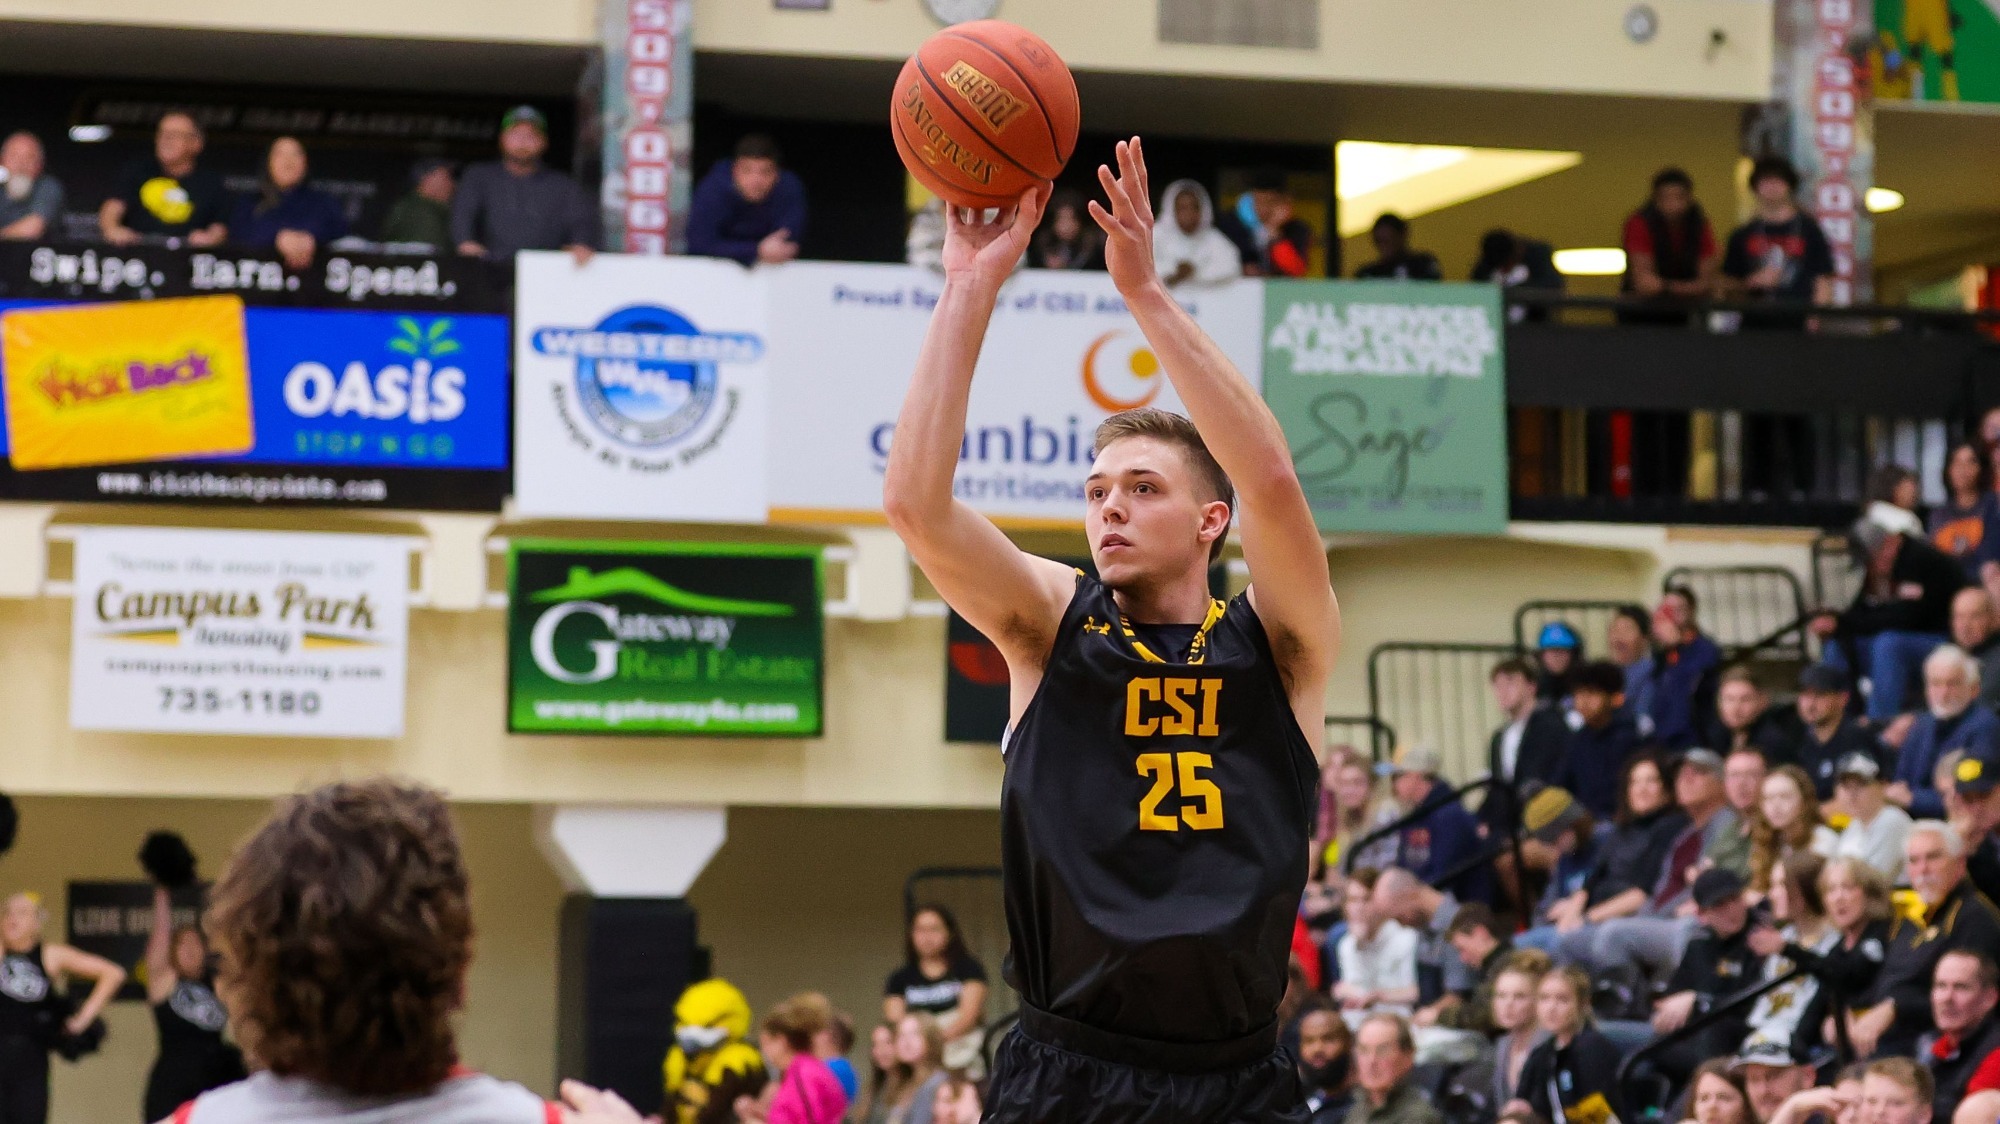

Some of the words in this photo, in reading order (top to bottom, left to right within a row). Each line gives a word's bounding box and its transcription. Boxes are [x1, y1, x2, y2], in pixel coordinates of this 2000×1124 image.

[948, 64, 1024, 130] NJCAA
[902, 80, 999, 185] SPALDING
[30, 247, 165, 295] Swipe.
[191, 254, 300, 291] Earn.
[326, 257, 457, 299] Spend.
[833, 283, 903, 308] Proud
[1286, 303, 1338, 327] ALL
[1346, 304, 1488, 329] SERVICES
[541, 331, 758, 361] WESTERN
[1269, 322, 1315, 349] AT
[1317, 324, 1365, 350] NO
[1369, 325, 1497, 354] CHARGE
[283, 357, 467, 424] OASIS
[97, 471, 387, 501] www.kickbackpoints.com
[96, 583, 262, 630] Campus
[275, 583, 377, 631] Park
[194, 625, 293, 654] housing
[529, 599, 736, 684] Gateway
[104, 658, 383, 683] campusparkhousing.com
[620, 647, 699, 682] Real
[706, 648, 815, 683] Estate
[158, 686, 322, 716] 735-1180
[1124, 676, 1223, 737] CSI
[1135, 751, 1224, 832] 25
